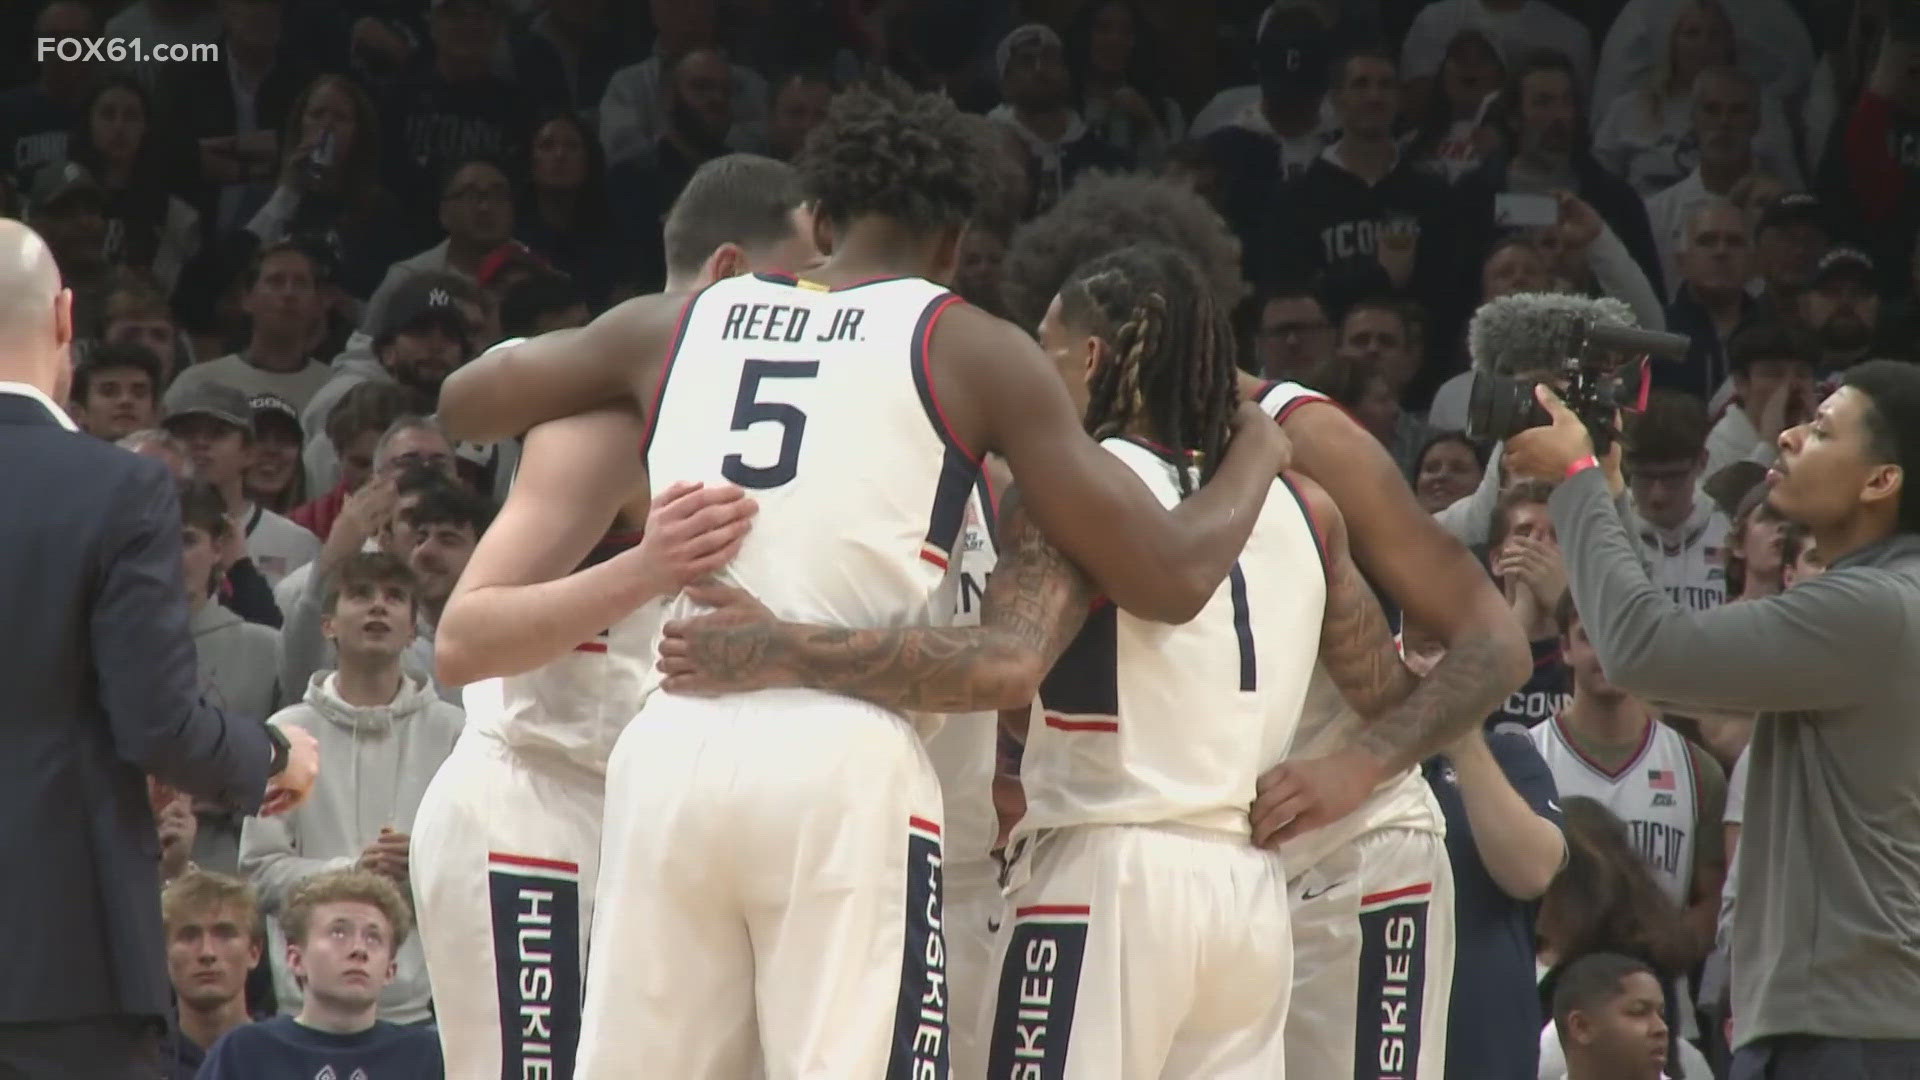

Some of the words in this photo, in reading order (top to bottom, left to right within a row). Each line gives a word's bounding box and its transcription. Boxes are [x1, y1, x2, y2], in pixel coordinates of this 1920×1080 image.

[722, 303, 811, 342] REED
[816, 308, 866, 342] JR.
[721, 358, 820, 489] 5
[1228, 560, 1257, 692] 1
[516, 888, 554, 1080] HUSKIE
